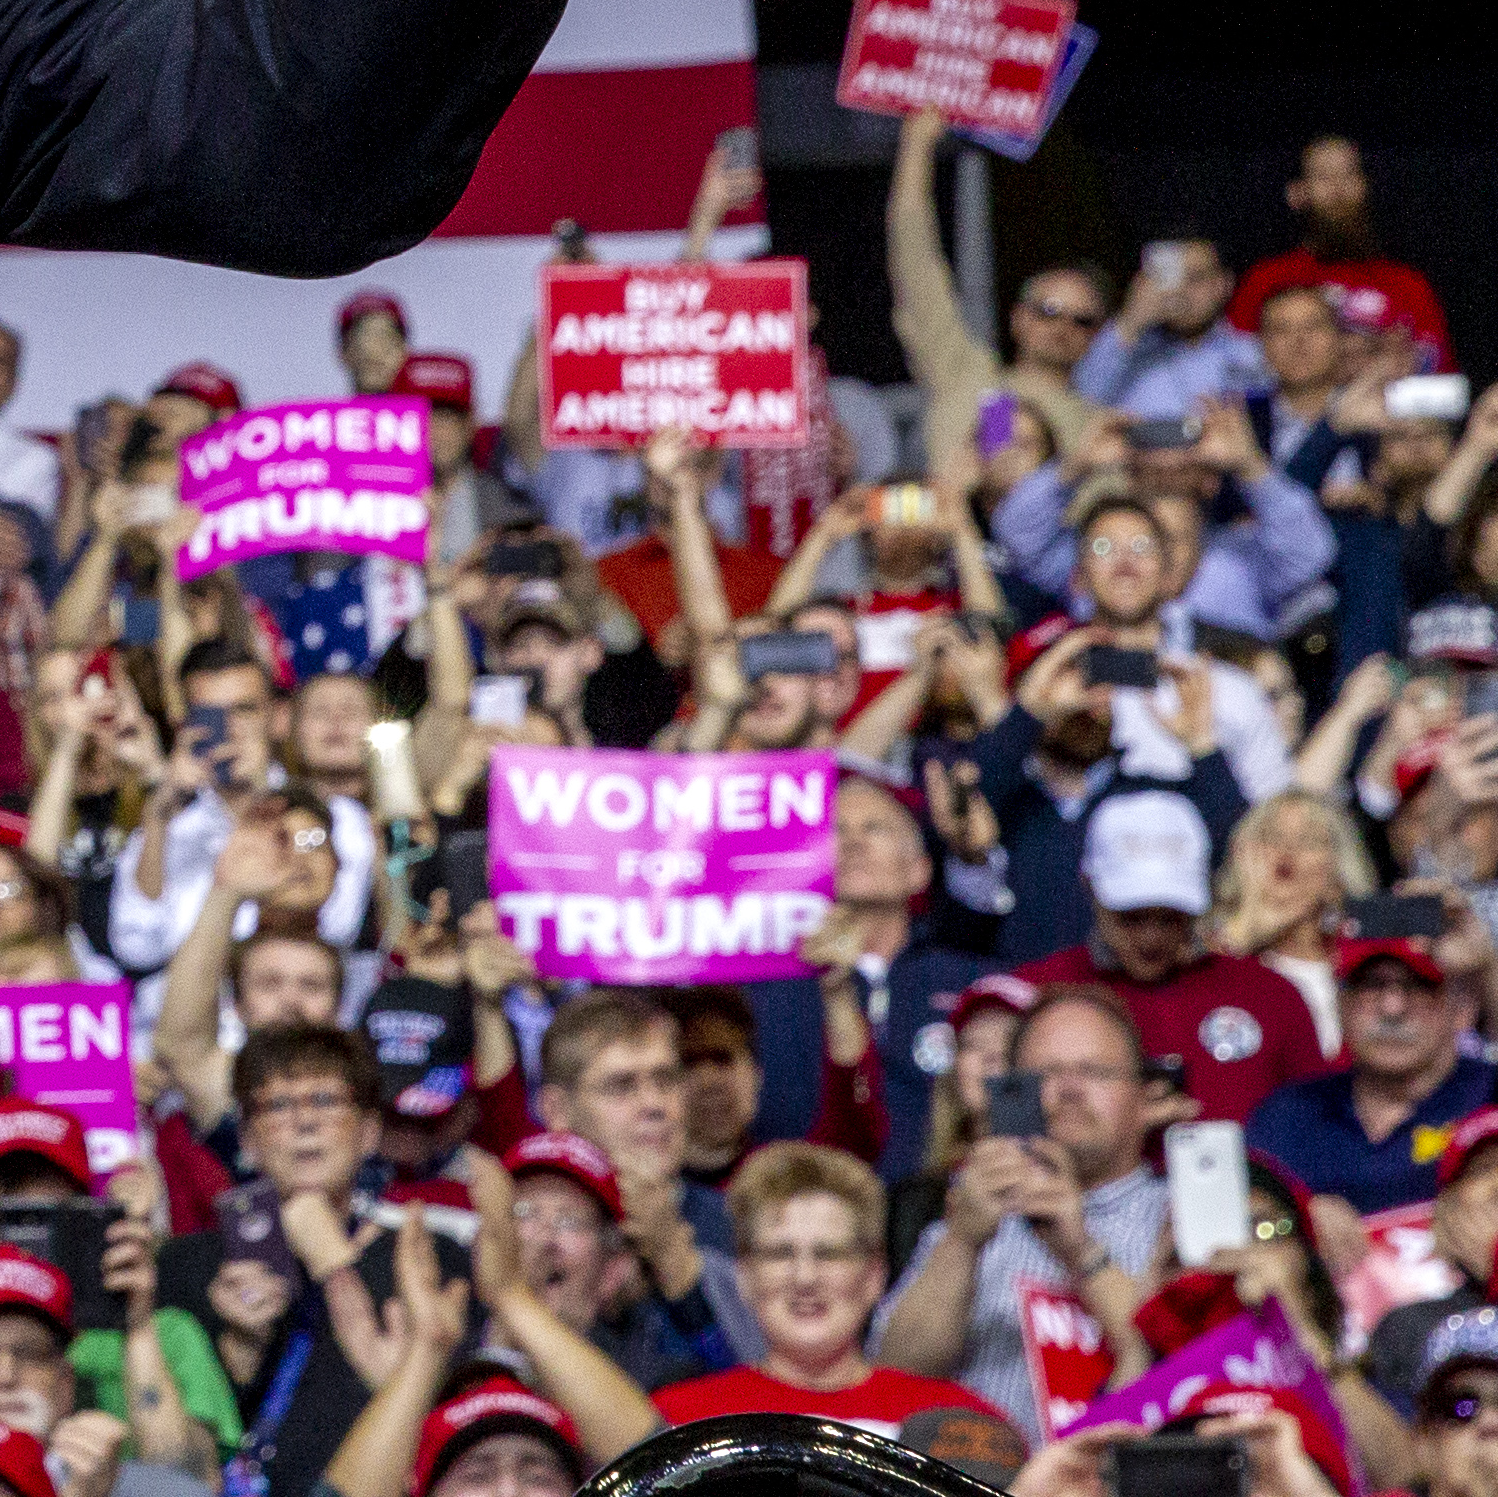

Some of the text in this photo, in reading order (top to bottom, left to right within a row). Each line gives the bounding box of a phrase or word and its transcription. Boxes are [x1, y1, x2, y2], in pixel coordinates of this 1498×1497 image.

[624, 278, 710, 310] BUY
[551, 311, 794, 354] AMERICAN
[554, 390, 796, 432] AMERICAN
[185, 407, 422, 481] WOMEN
[187, 487, 430, 563] TRUMP
[506, 766, 826, 832] WOMEN
[615, 850, 707, 886] FOR
[496, 891, 828, 958] TRUMP
